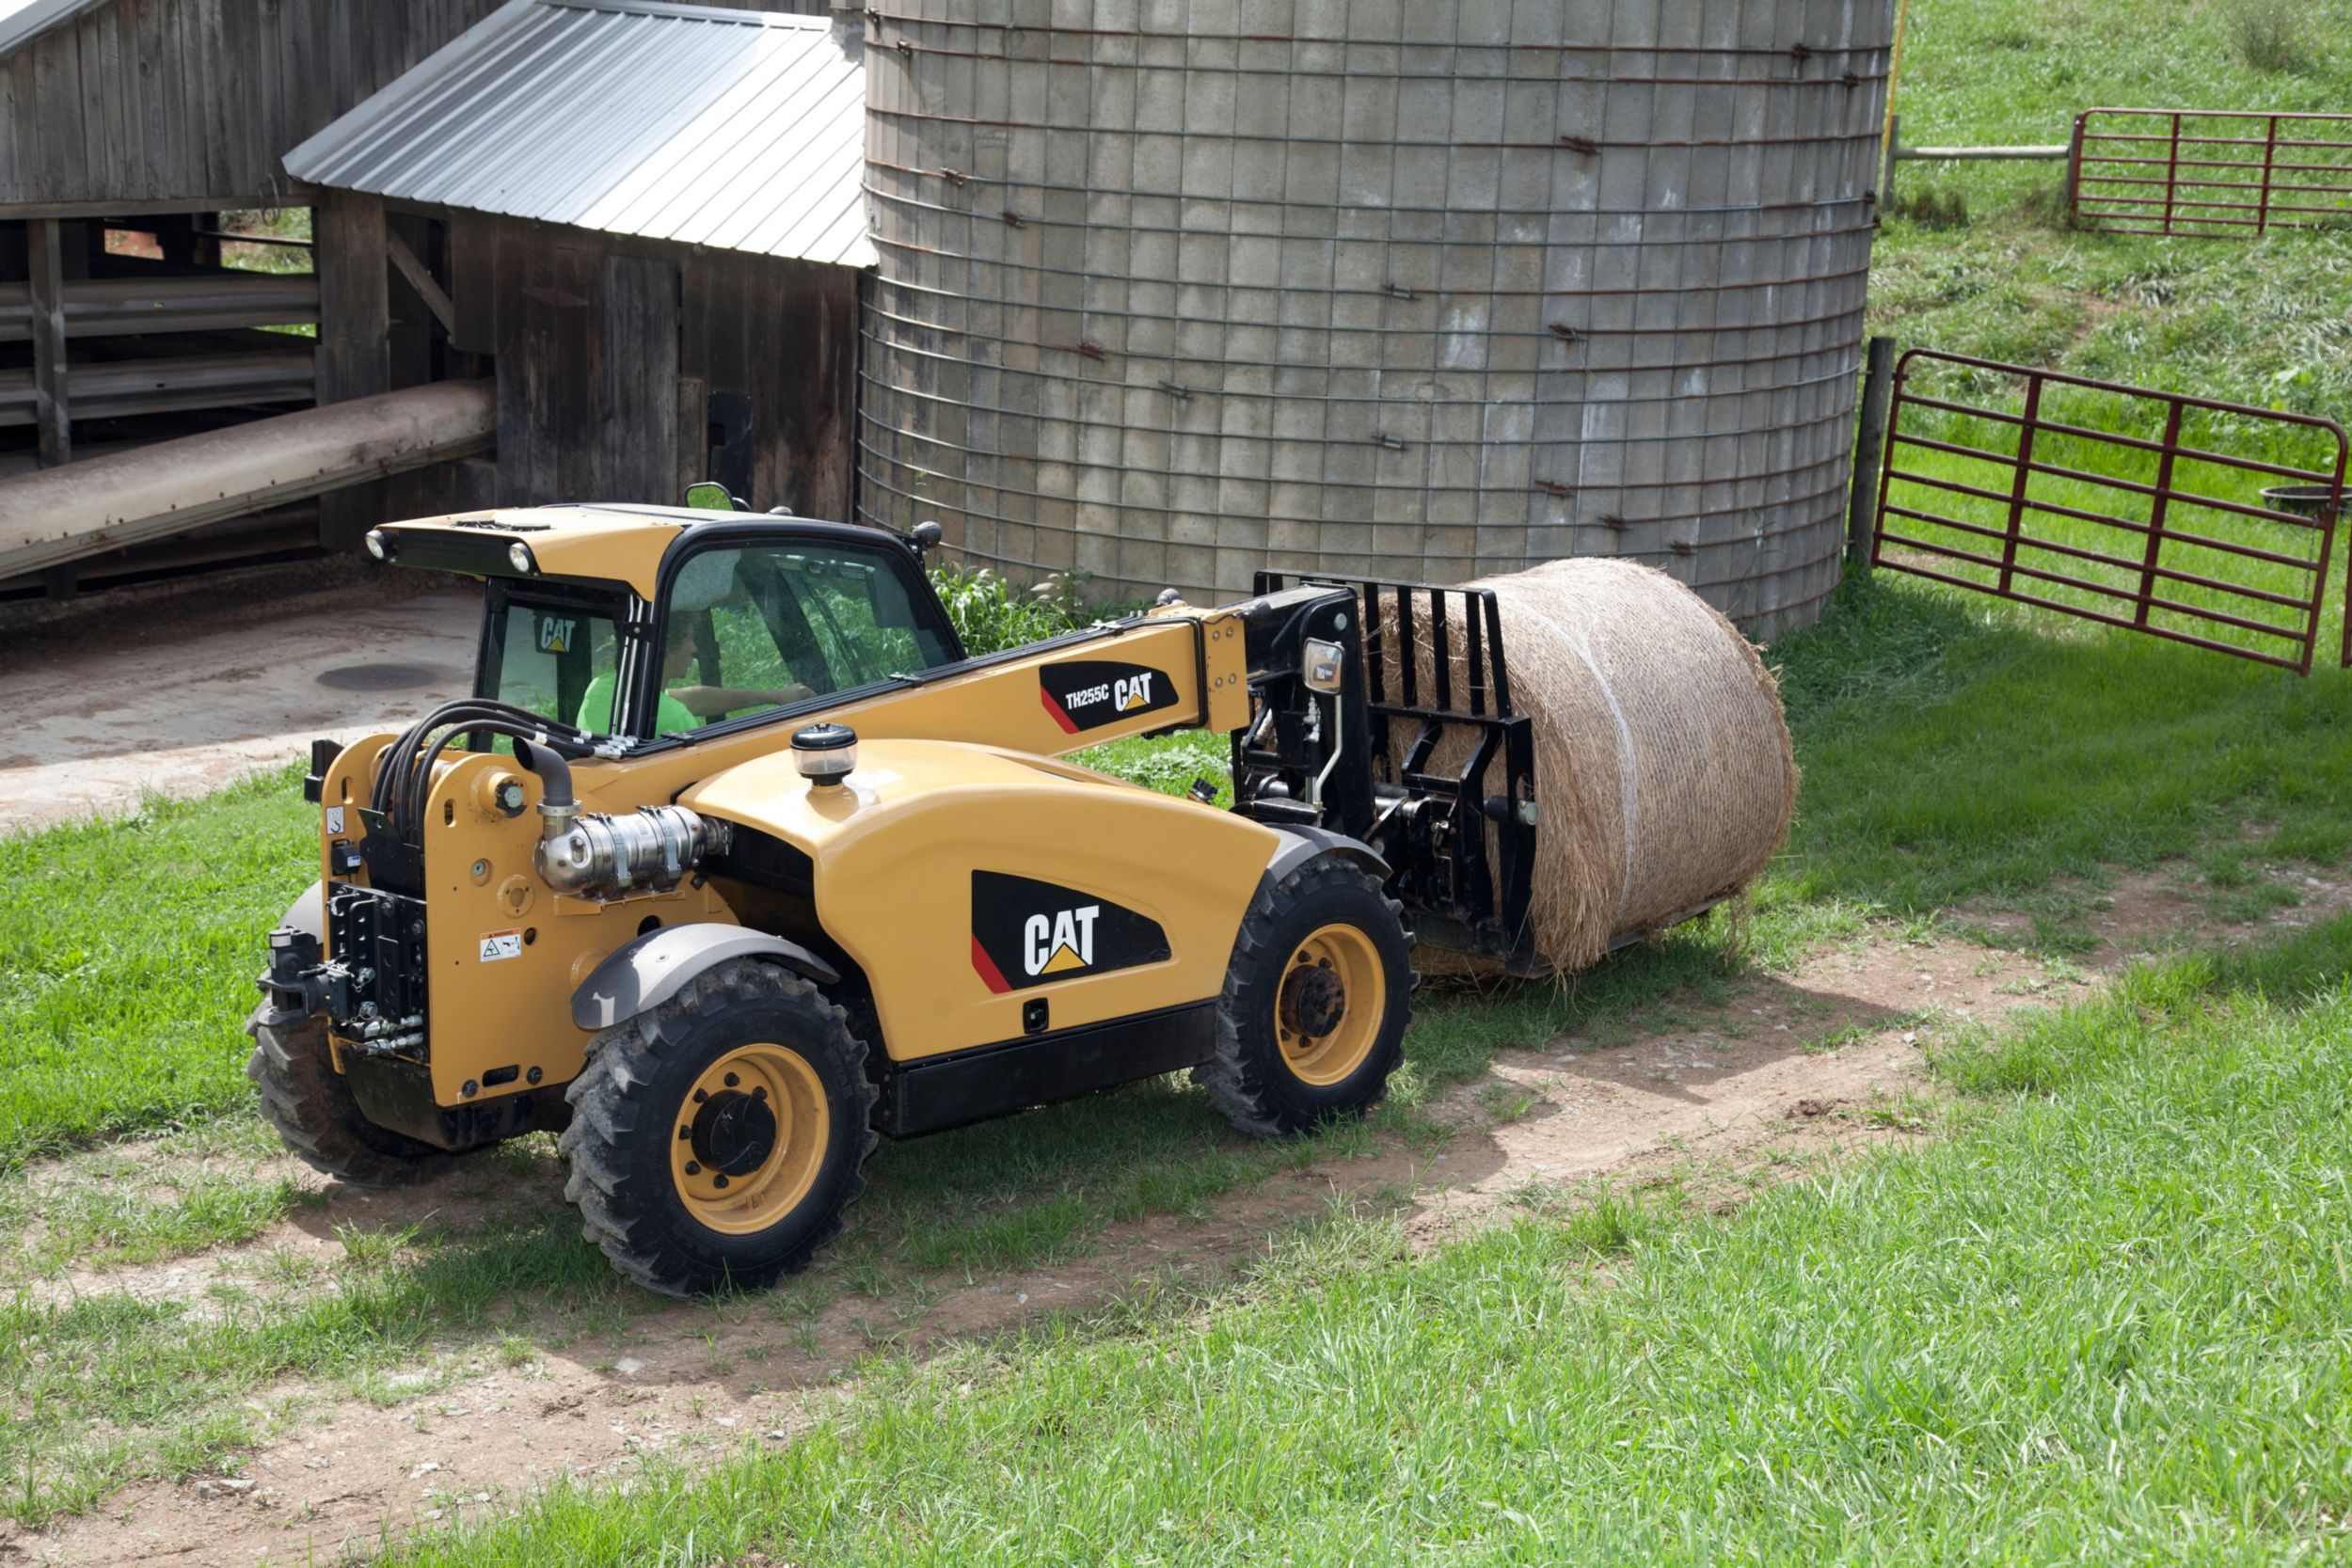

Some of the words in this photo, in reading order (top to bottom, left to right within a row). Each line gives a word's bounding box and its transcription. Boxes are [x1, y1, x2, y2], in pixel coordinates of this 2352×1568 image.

[541, 616, 576, 653] CAT
[1065, 683, 1110, 710] TH255C
[1114, 672, 1152, 712] CAT
[1025, 905, 1100, 976] CAT
